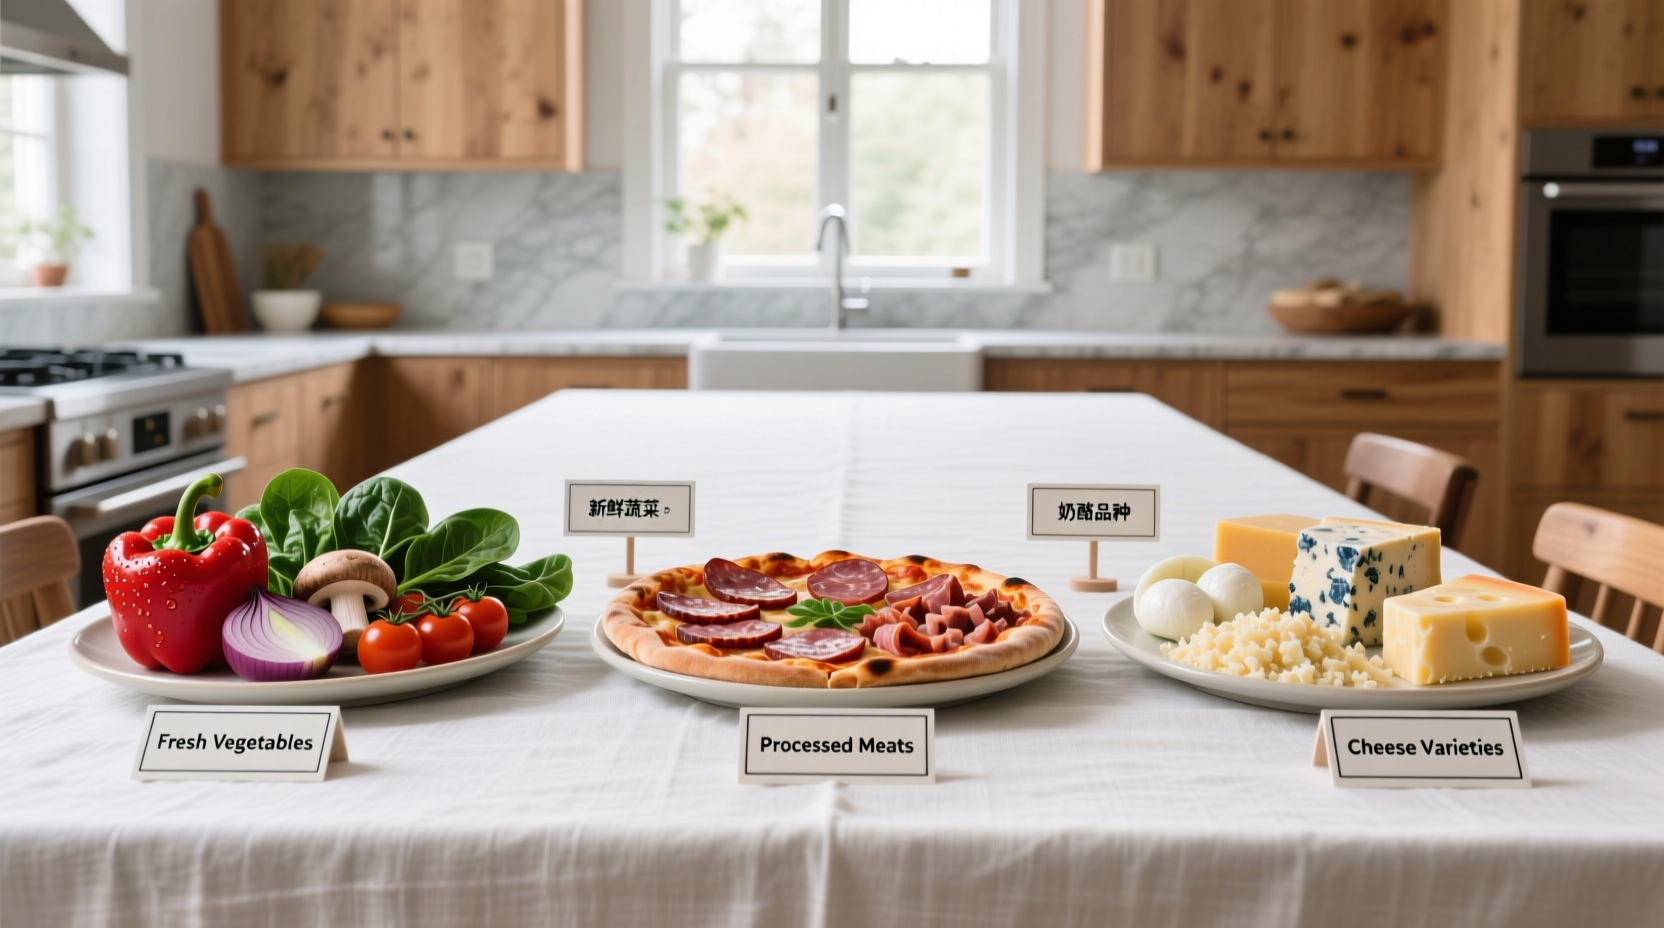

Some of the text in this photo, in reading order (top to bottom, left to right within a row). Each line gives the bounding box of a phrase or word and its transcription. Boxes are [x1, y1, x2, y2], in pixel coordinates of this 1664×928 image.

[157, 733, 313, 755] Fresh Vegetables
[760, 736, 914, 754] Processed Meats
[1347, 738, 1504, 756] Cheese Varieties
